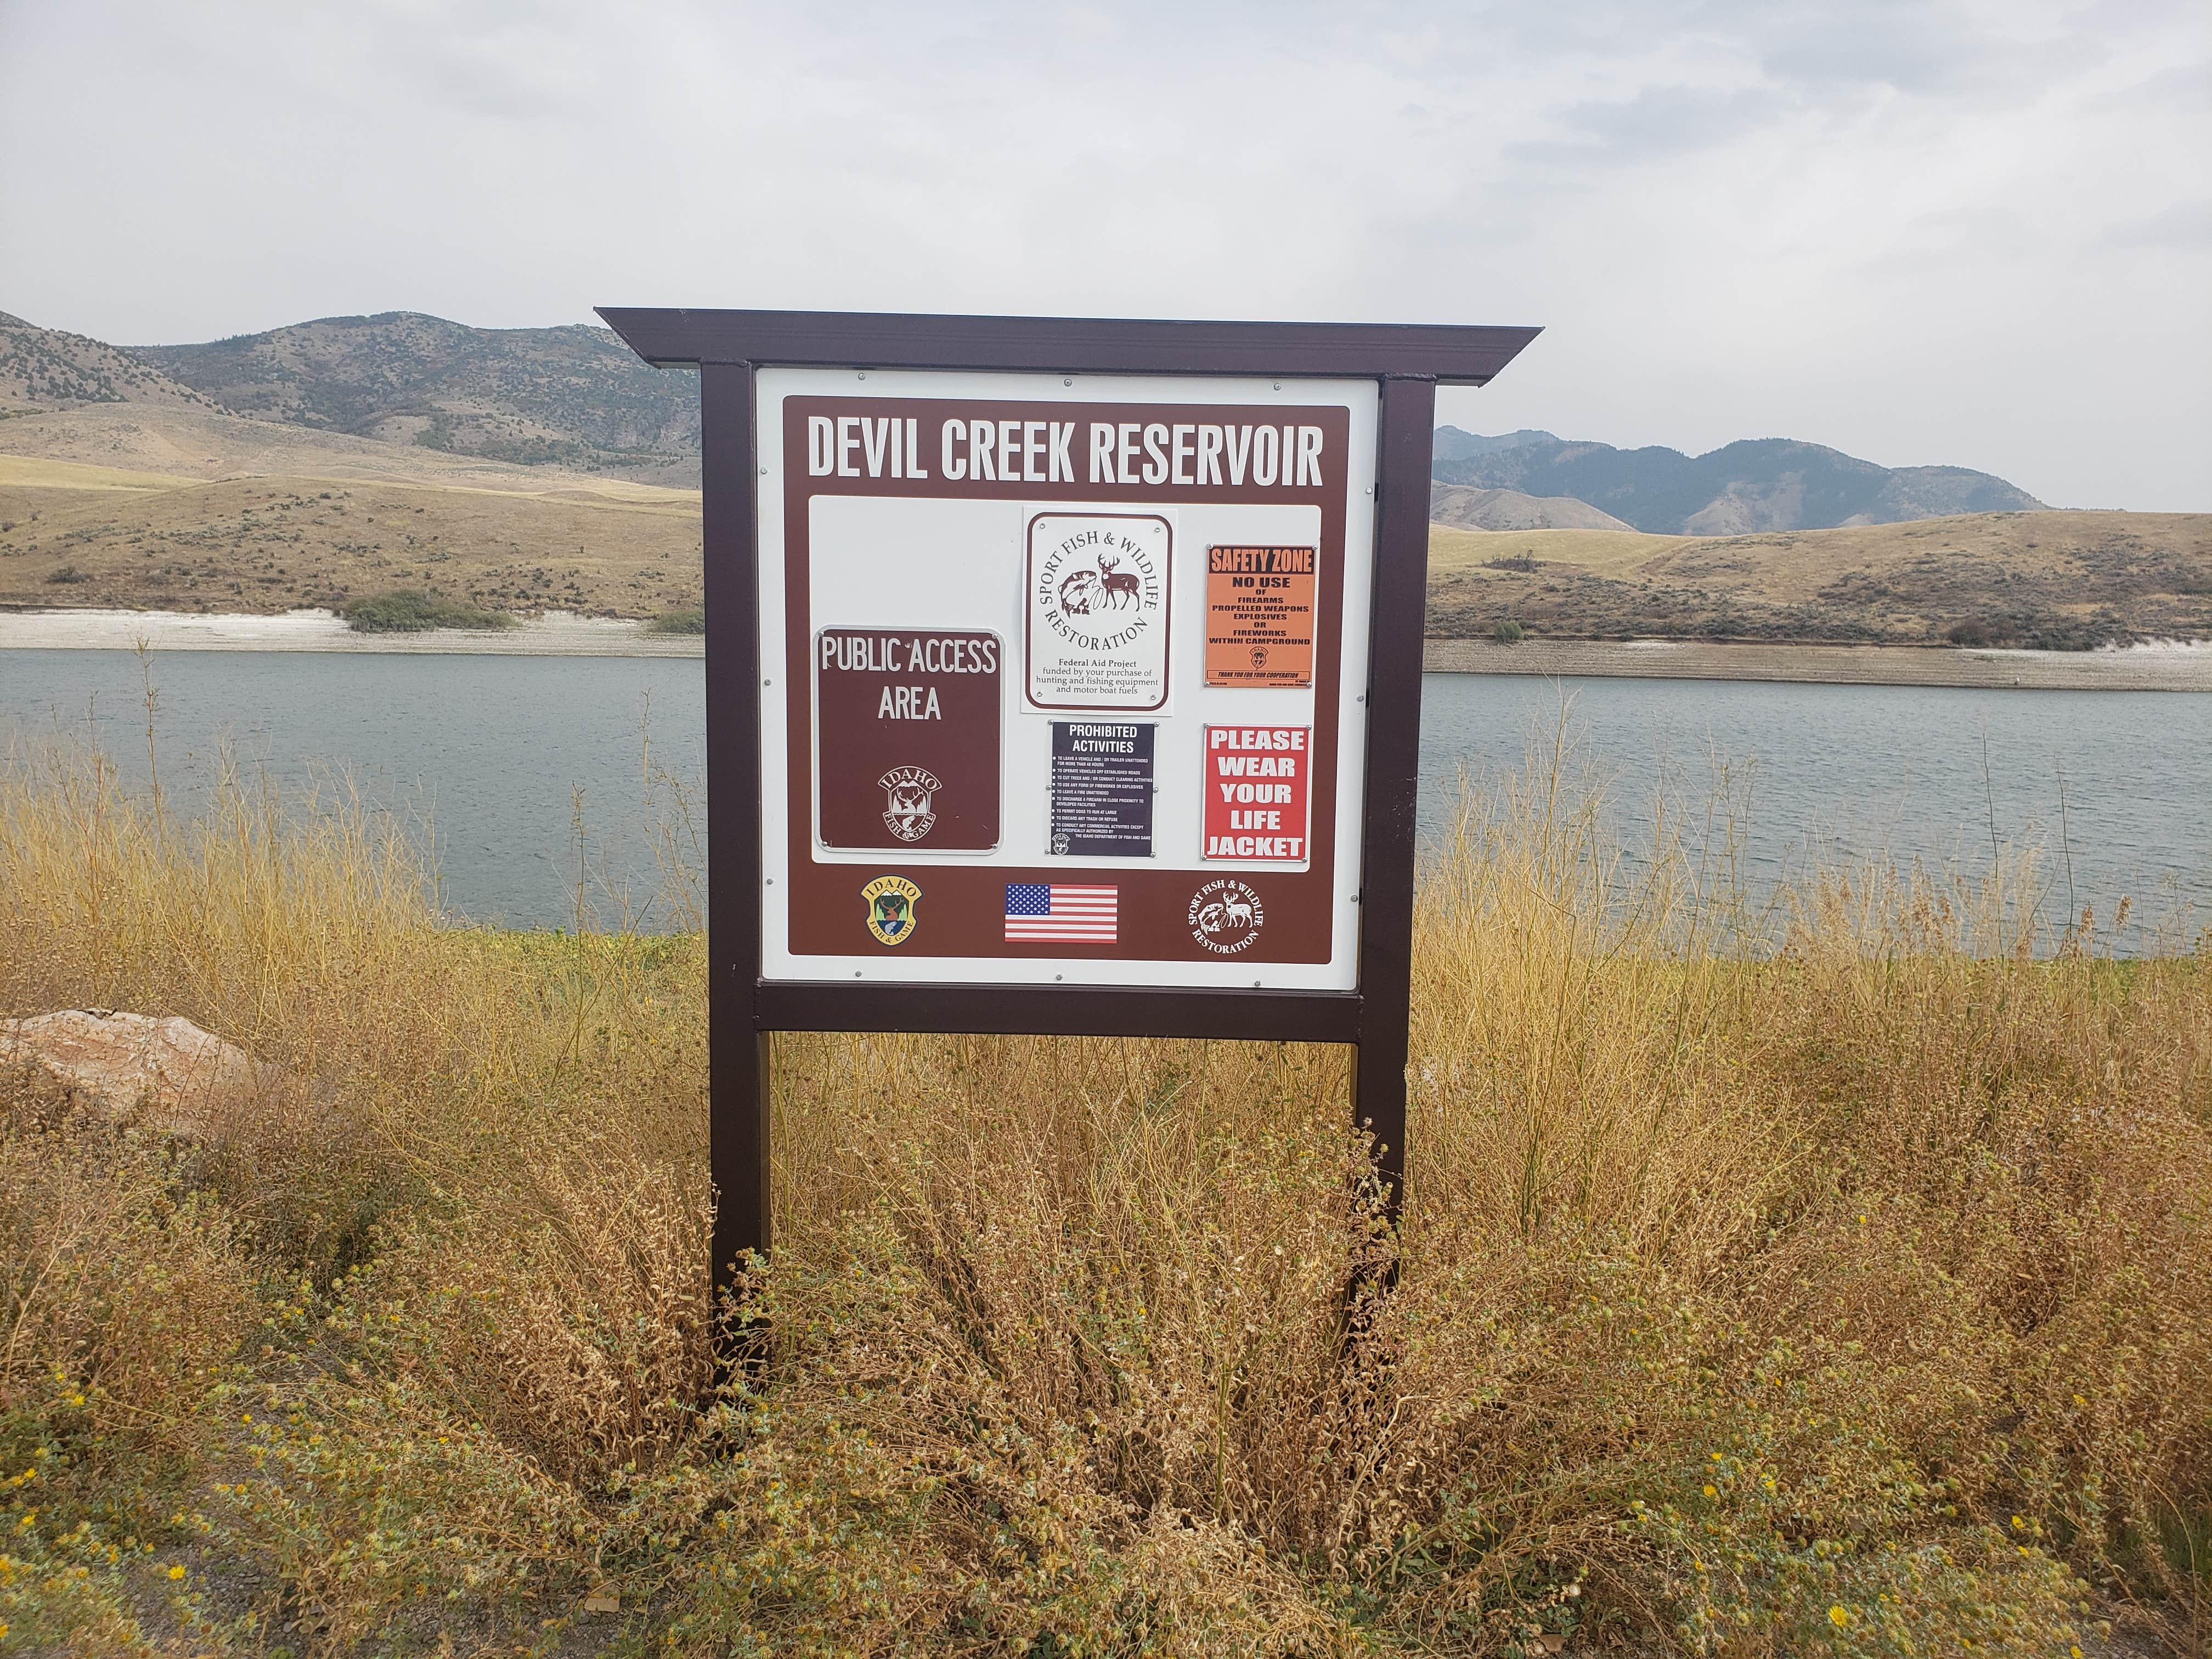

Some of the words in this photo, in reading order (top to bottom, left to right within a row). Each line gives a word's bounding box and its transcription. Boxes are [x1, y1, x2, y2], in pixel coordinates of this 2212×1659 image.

[808, 416, 928, 479] DEVIL
[941, 419, 1076, 483] CREEK
[1089, 423, 1323, 486] RESERVOIR
[1040, 551, 1063, 604] SPORT
[1061, 531, 1098, 555] FISH
[1104, 532, 1115, 545] &
[1120, 537, 1159, 610] WILDLIFE
[1212, 549, 1269, 572] SAFETY
[1272, 550, 1312, 572] ZONE
[1233, 577, 1254, 587] NO
[1260, 578, 1290, 588] USE
[1045, 609, 1148, 650] RESTORATION
[823, 636, 901, 672] PUBLIC
[908, 639, 996, 674] ACCESS
[1108, 661, 1136, 669] Project
[1036, 676, 1066, 685] hunting
[1087, 678, 1113, 686] fishing
[1074, 668, 1083, 676] by
[878, 686, 941, 720] AREA
[1070, 725, 1137, 737] PROHIBITED
[1211, 730, 1304, 750] PLEASE
[1073, 740, 1133, 753] ACTIVITIES
[1217, 757, 1295, 776] WEAR
[881, 769, 937, 789] IDAHO
[1220, 784, 1291, 803] YOUR
[885, 813, 901, 834] FISH
[912, 815, 933, 838] GAME
[1231, 810, 1280, 830] LIFE
[1207, 837, 1302, 856] JACKET
[866, 878, 916, 896] IDAHO
[1188, 892, 1204, 925] SPORT
[1201, 879, 1225, 895] FISH
[1228, 880, 1236, 889] &
[1239, 882, 1263, 927] WILDLIFE
[870, 921, 884, 939] FISH
[895, 921, 913, 941] GAME
[1192, 929, 1259, 953] RESTORATION
